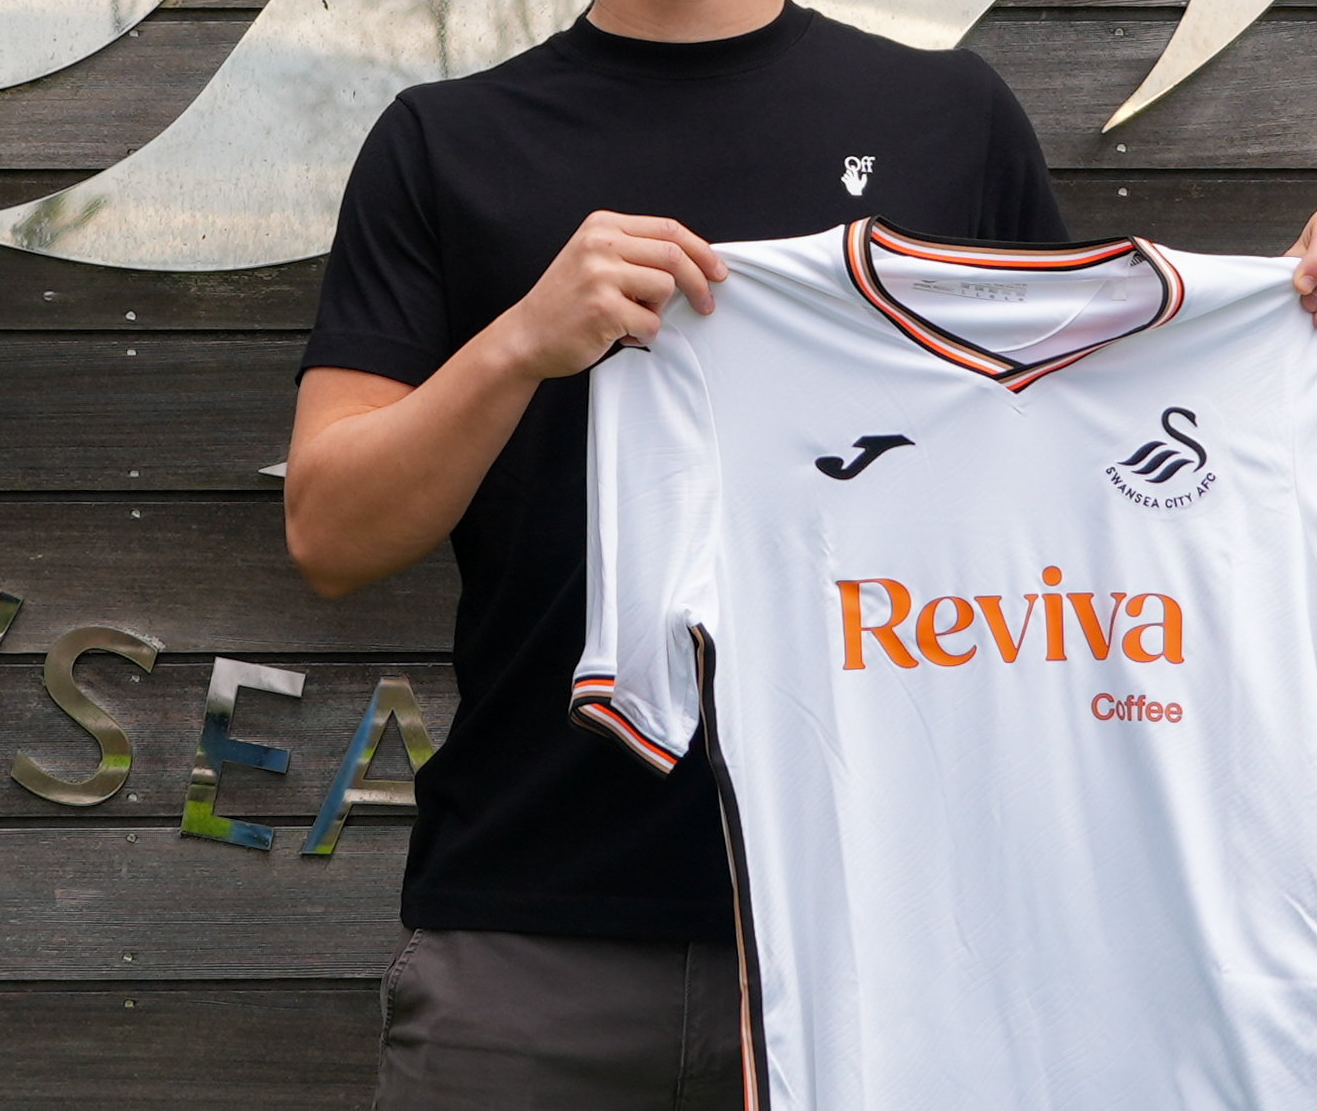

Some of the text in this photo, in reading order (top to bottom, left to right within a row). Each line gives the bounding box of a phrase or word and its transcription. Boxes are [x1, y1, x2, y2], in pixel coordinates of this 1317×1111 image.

[844, 155, 876, 173] Off
[1105, 466, 1216, 509] SWANSEA CITY AFC
[835, 565, 1185, 670] Reviva
[1091, 693, 1183, 723] Coffee
